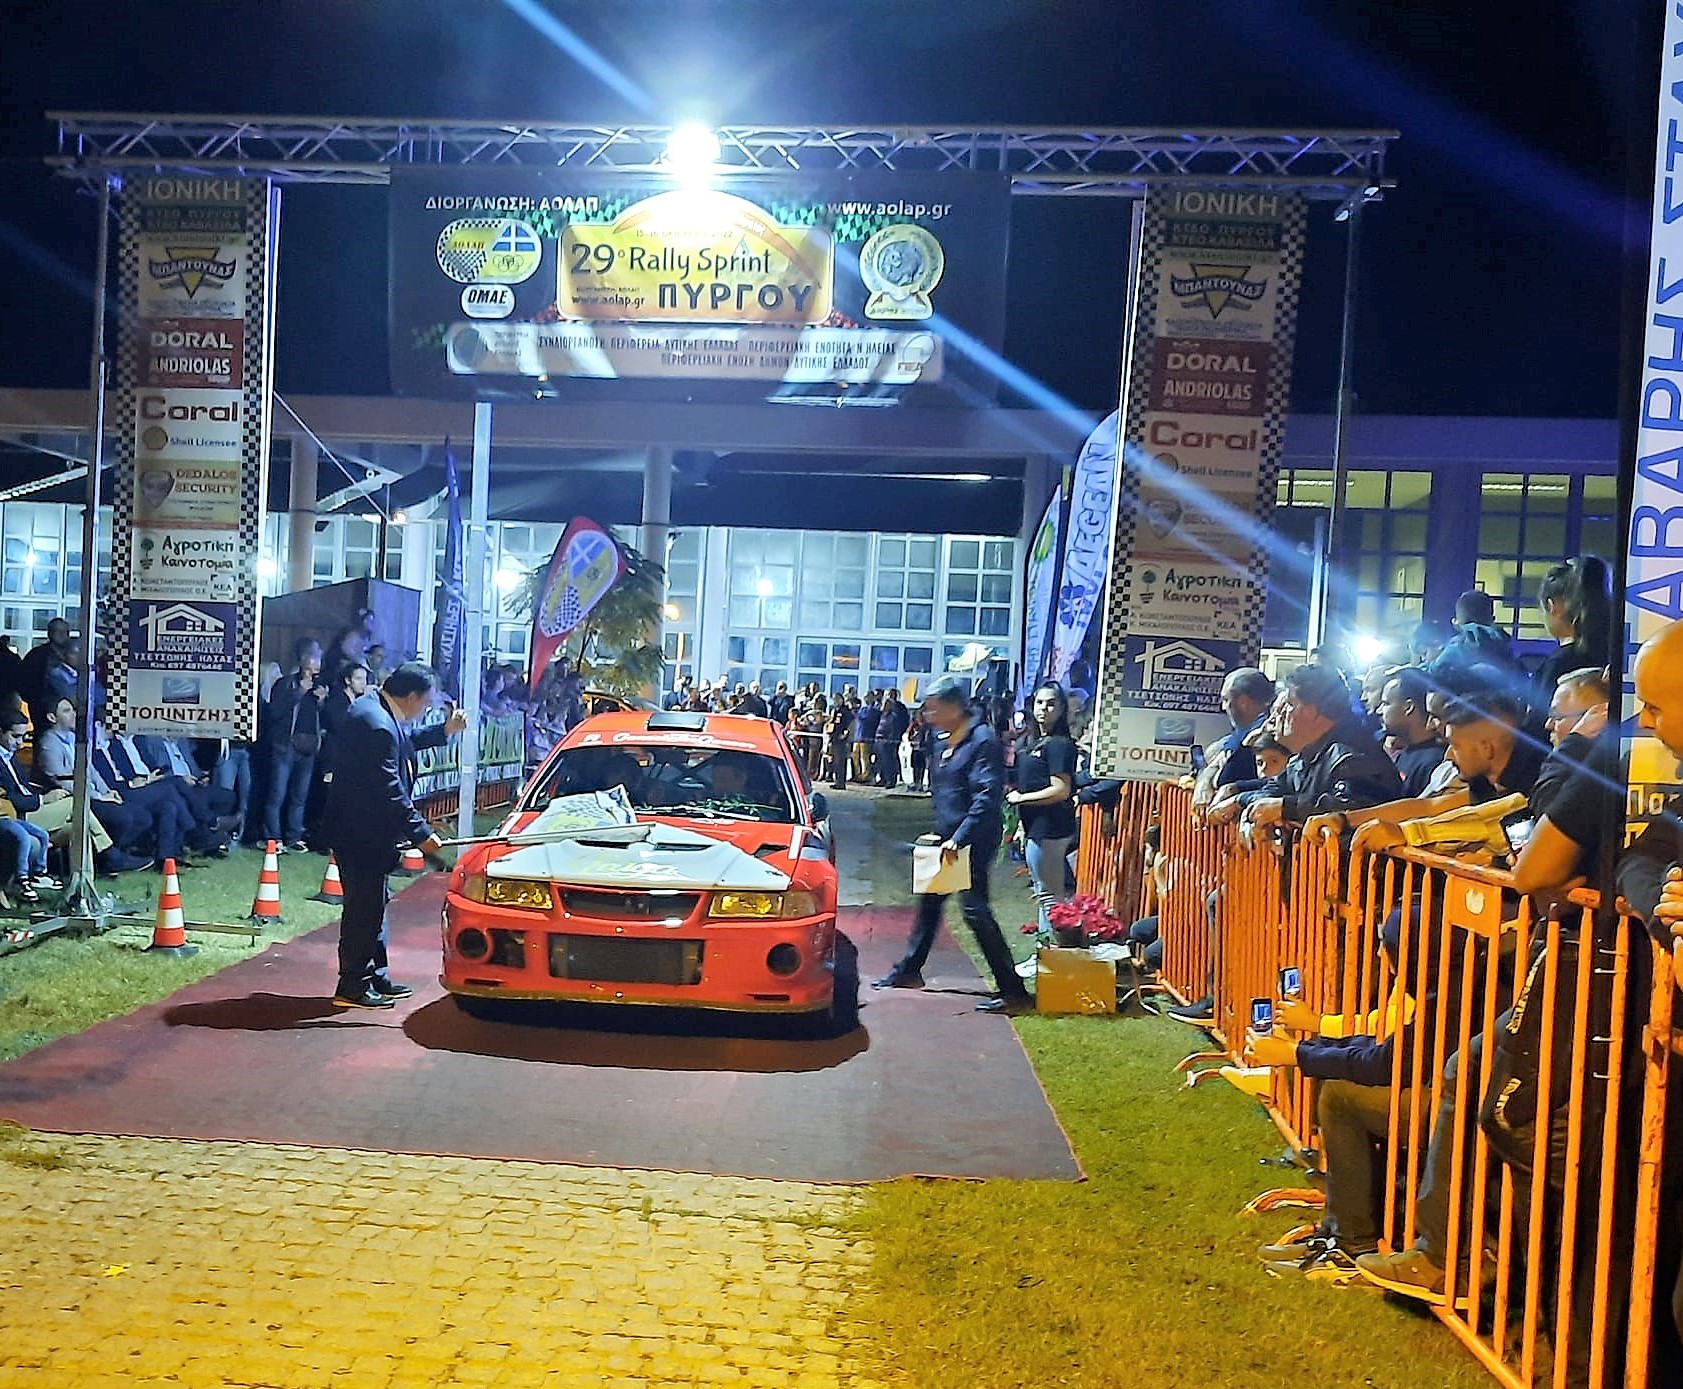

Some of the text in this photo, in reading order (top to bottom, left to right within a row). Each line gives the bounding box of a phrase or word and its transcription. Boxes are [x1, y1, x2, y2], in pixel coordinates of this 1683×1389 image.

[147, 179, 240, 200] ΙΟΝΙΚΗ
[425, 196, 599, 212] ΔΙΟΡΓΑΝΩΣΗ: ΑΟΛΑΠ
[827, 200, 952, 219] www.aolap.gr
[1175, 191, 1278, 216] ΙΟΝΙΚΗ
[629, 246, 690, 279] Rally
[697, 247, 771, 278] Sprint
[658, 282, 812, 313] ΠΥΡΓΟΥ
[150, 331, 235, 349] DORAL
[1166, 353, 1257, 373] DORAL
[1163, 380, 1252, 400] ANDRIOLAS
[141, 396, 238, 421] Coral
[1150, 420, 1258, 451] Coral
[174, 483, 237, 494] SECURITY
[1066, 442, 1117, 579] AEGEAN
[162, 536, 234, 555] Αγροτική
[130, 706, 231, 722] ΤΟΠΙΝΤΖΗΣ
[1120, 747, 1190, 764] ΤΟΠΙΝΤ
